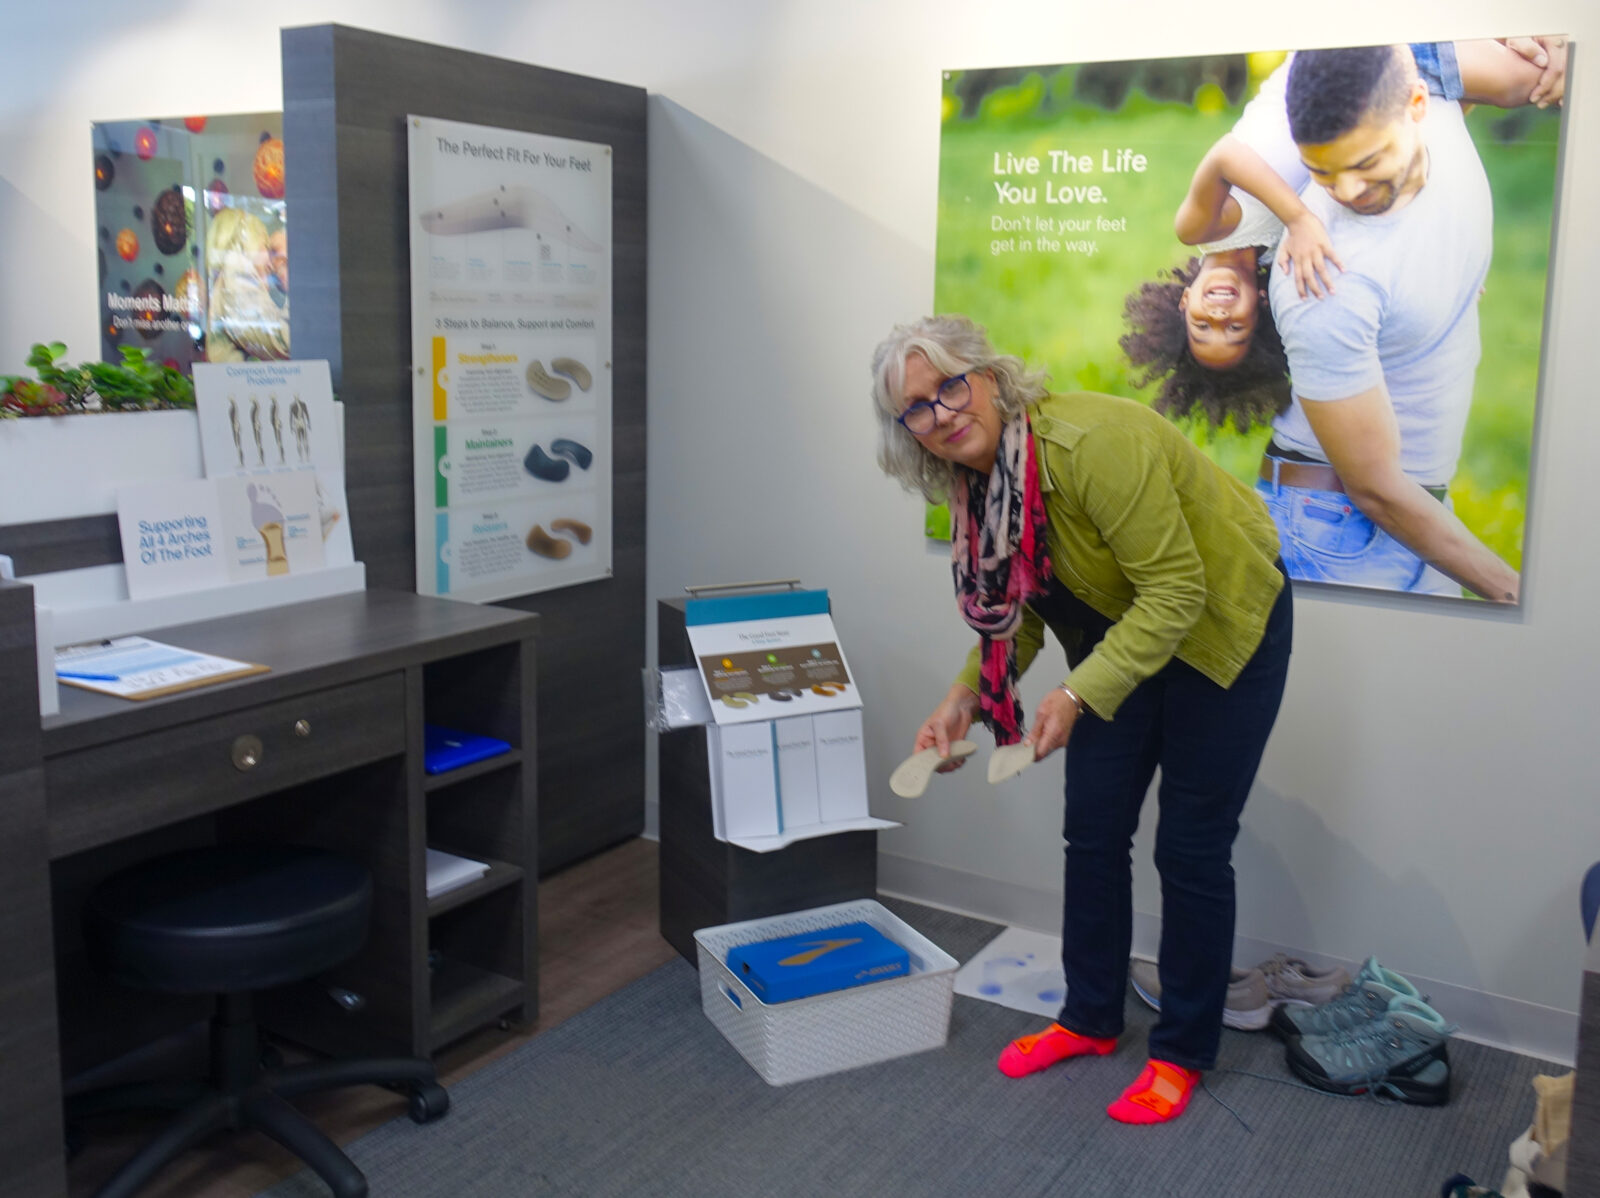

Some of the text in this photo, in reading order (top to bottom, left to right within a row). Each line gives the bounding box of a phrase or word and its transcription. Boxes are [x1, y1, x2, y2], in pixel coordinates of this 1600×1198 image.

[437, 137, 592, 172] The Perfect Fit For Your Feet
[993, 149, 1148, 175] Live The Life
[994, 181, 1108, 205] You Love.
[991, 215, 1127, 236] Don't let your feet
[990, 237, 1099, 257] get in the way.
[107, 292, 161, 312] Moments
[470, 318, 480, 329] to
[549, 319, 564, 330] and
[138, 515, 207, 533] Supporting
[140, 535, 155, 550] All
[168, 531, 211, 546] Arches
[141, 544, 213, 566] Of The Foot
